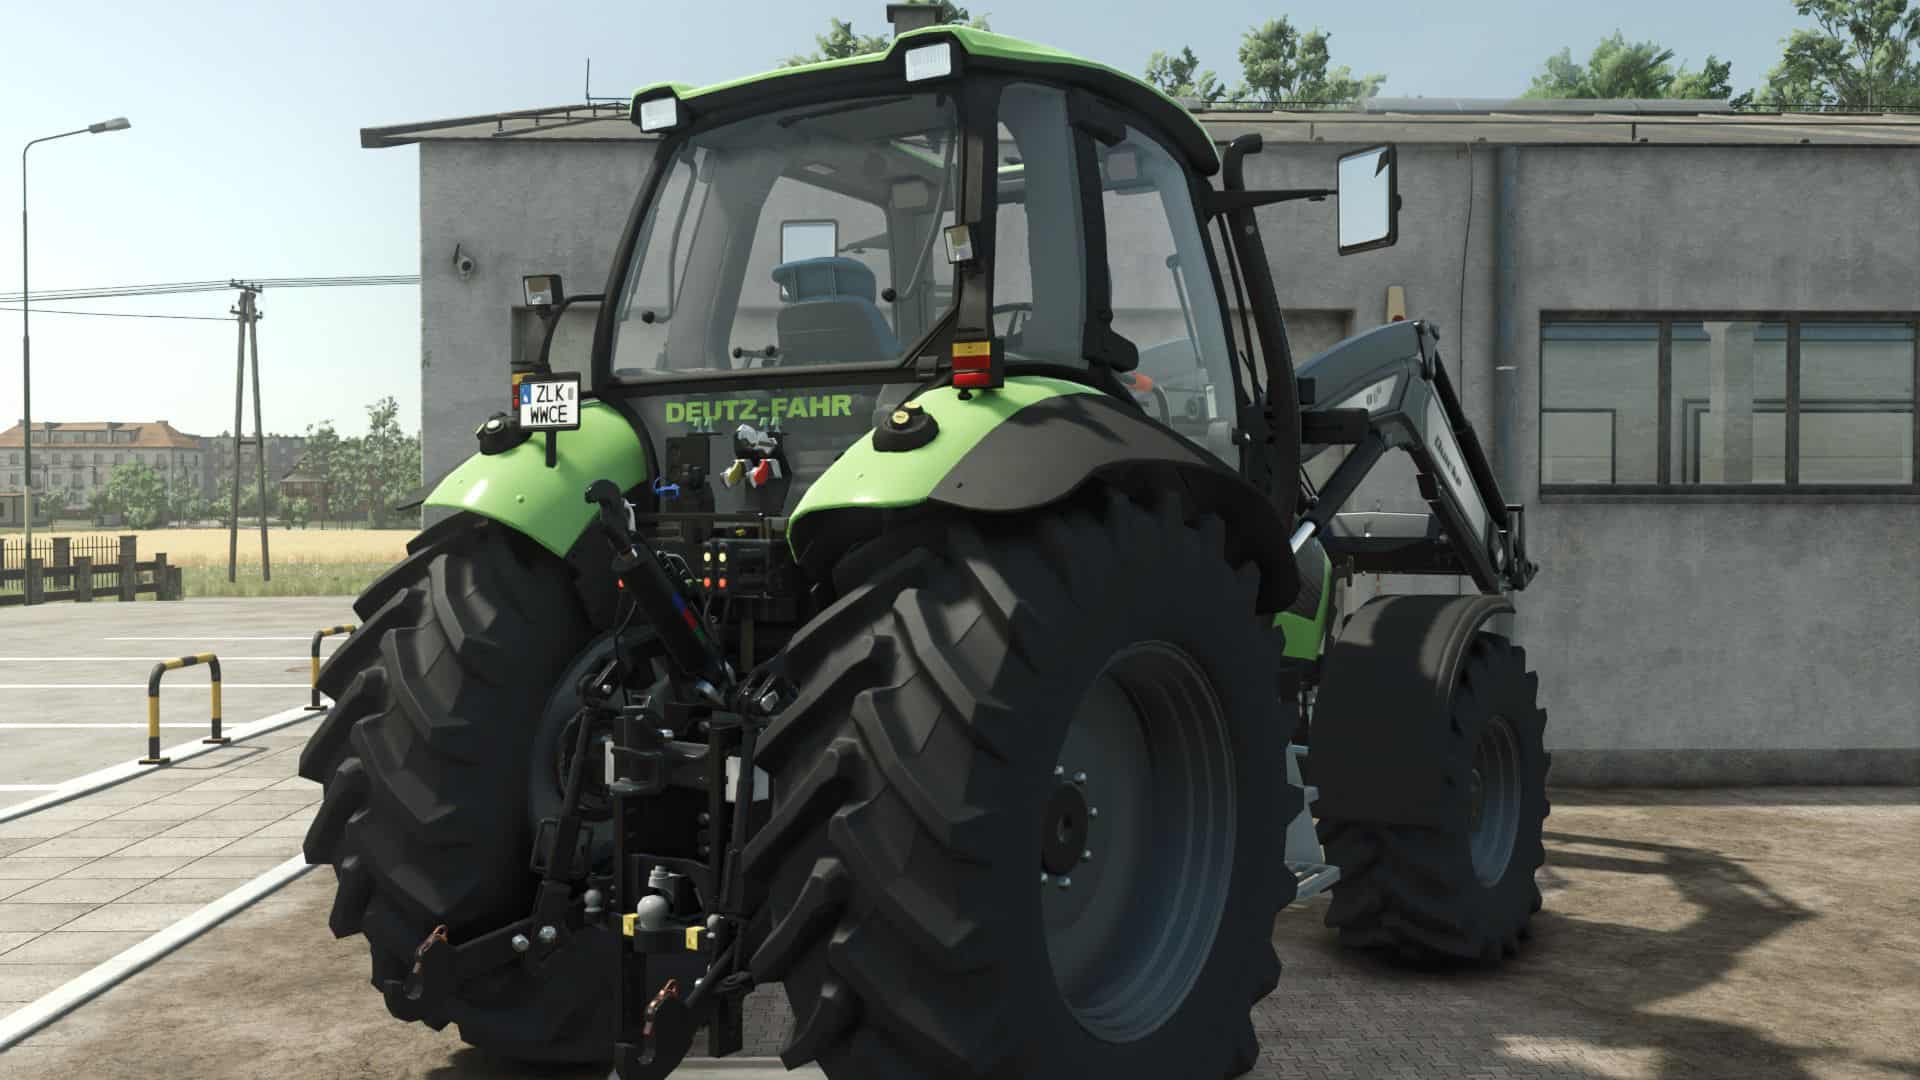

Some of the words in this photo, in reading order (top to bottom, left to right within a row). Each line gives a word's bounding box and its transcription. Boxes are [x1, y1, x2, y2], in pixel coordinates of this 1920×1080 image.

[536, 384, 564, 403] ZLK
[530, 405, 568, 424] WWCE
[665, 395, 852, 424] DEUTZ-FAHR
